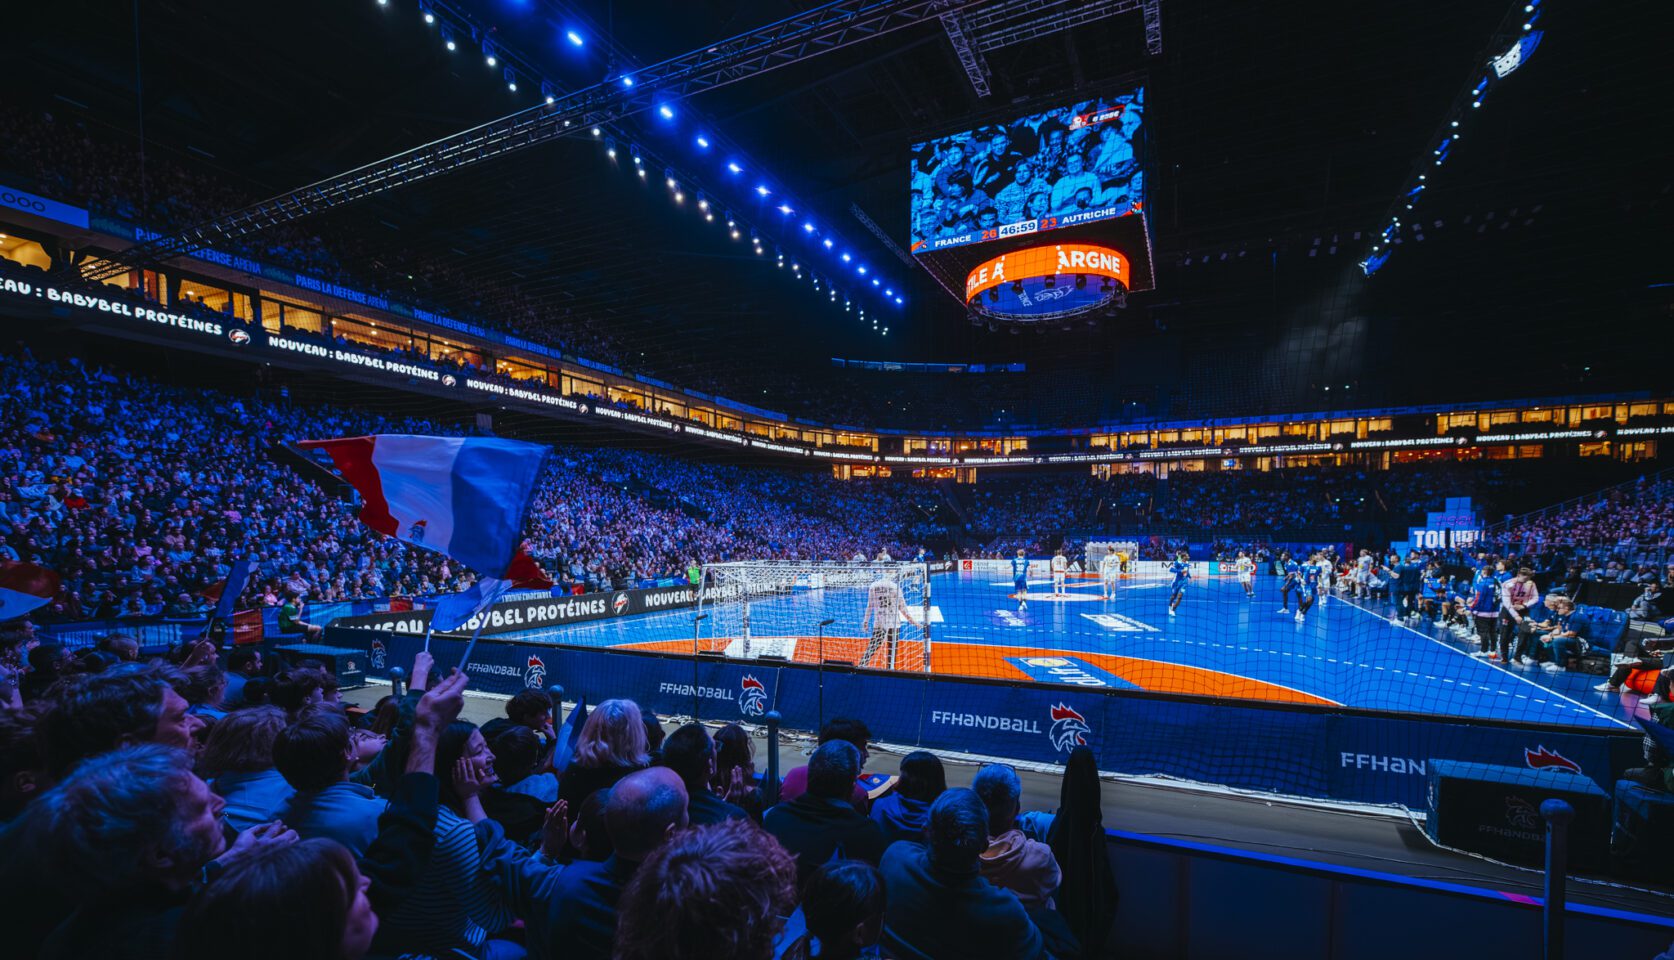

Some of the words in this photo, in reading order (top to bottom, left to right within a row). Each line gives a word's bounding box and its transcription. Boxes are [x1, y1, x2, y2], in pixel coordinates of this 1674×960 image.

[935, 234, 971, 248] FRANCE
[981, 229, 997, 240] 26
[1000, 222, 1036, 236] 46:59
[1040, 218, 1057, 230] 23
[1062, 207, 1116, 224] AUTRICHE
[295, 273, 321, 292] PARIS
[321, 281, 333, 295] LA
[47, 288, 131, 316] BABYBEL
[135, 307, 223, 335] PROTÉINES
[268, 336, 327, 357] NOUVEAU
[335, 350, 385, 369] BABYBEL
[386, 361, 439, 381] PROTÉINES
[467, 379, 504, 394] NOUVEAU
[509, 387, 541, 402] BABYBEL
[541, 395, 578, 410] PROTÉINES
[527, 599, 606, 622] PROTÉINES
